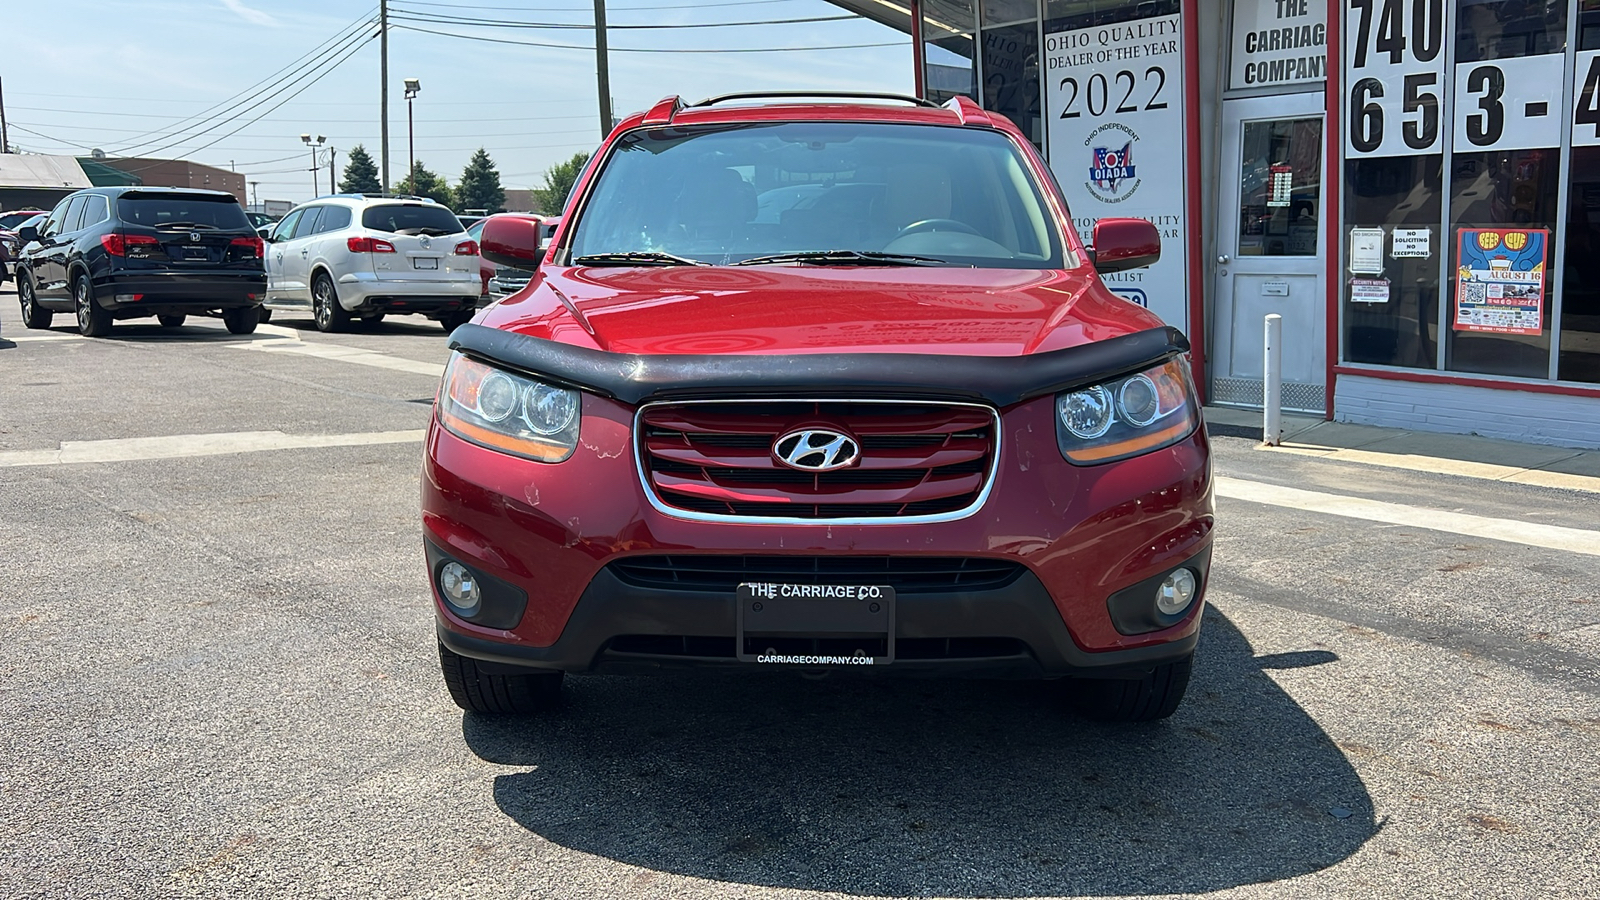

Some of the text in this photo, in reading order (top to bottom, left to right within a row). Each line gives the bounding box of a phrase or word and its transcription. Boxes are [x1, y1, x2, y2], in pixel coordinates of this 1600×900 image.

[1275, 0, 1307, 19] THE
[1047, 19, 1179, 52] OHIO QUALITY
[1245, 23, 1327, 54] CARRIAG
[1350, 0, 1441, 68] 740
[1049, 40, 1177, 69] DEALER OF THE YEAR
[1060, 66, 1168, 119] 2022
[1084, 122, 1141, 146] OHIO INDEPENDENT
[1095, 167, 1128, 180] OIADA
[1084, 182, 1104, 202] AUTOMOBILE
[1121, 178, 1142, 201] ASSOCIATION
[1479, 232, 1499, 249] BEER
[1489, 271, 1541, 280] AUGUST 16
[749, 583, 883, 599] THE CARRIAGE CO.
[757, 655, 874, 665] CARRIAGECOMPANY.COM
